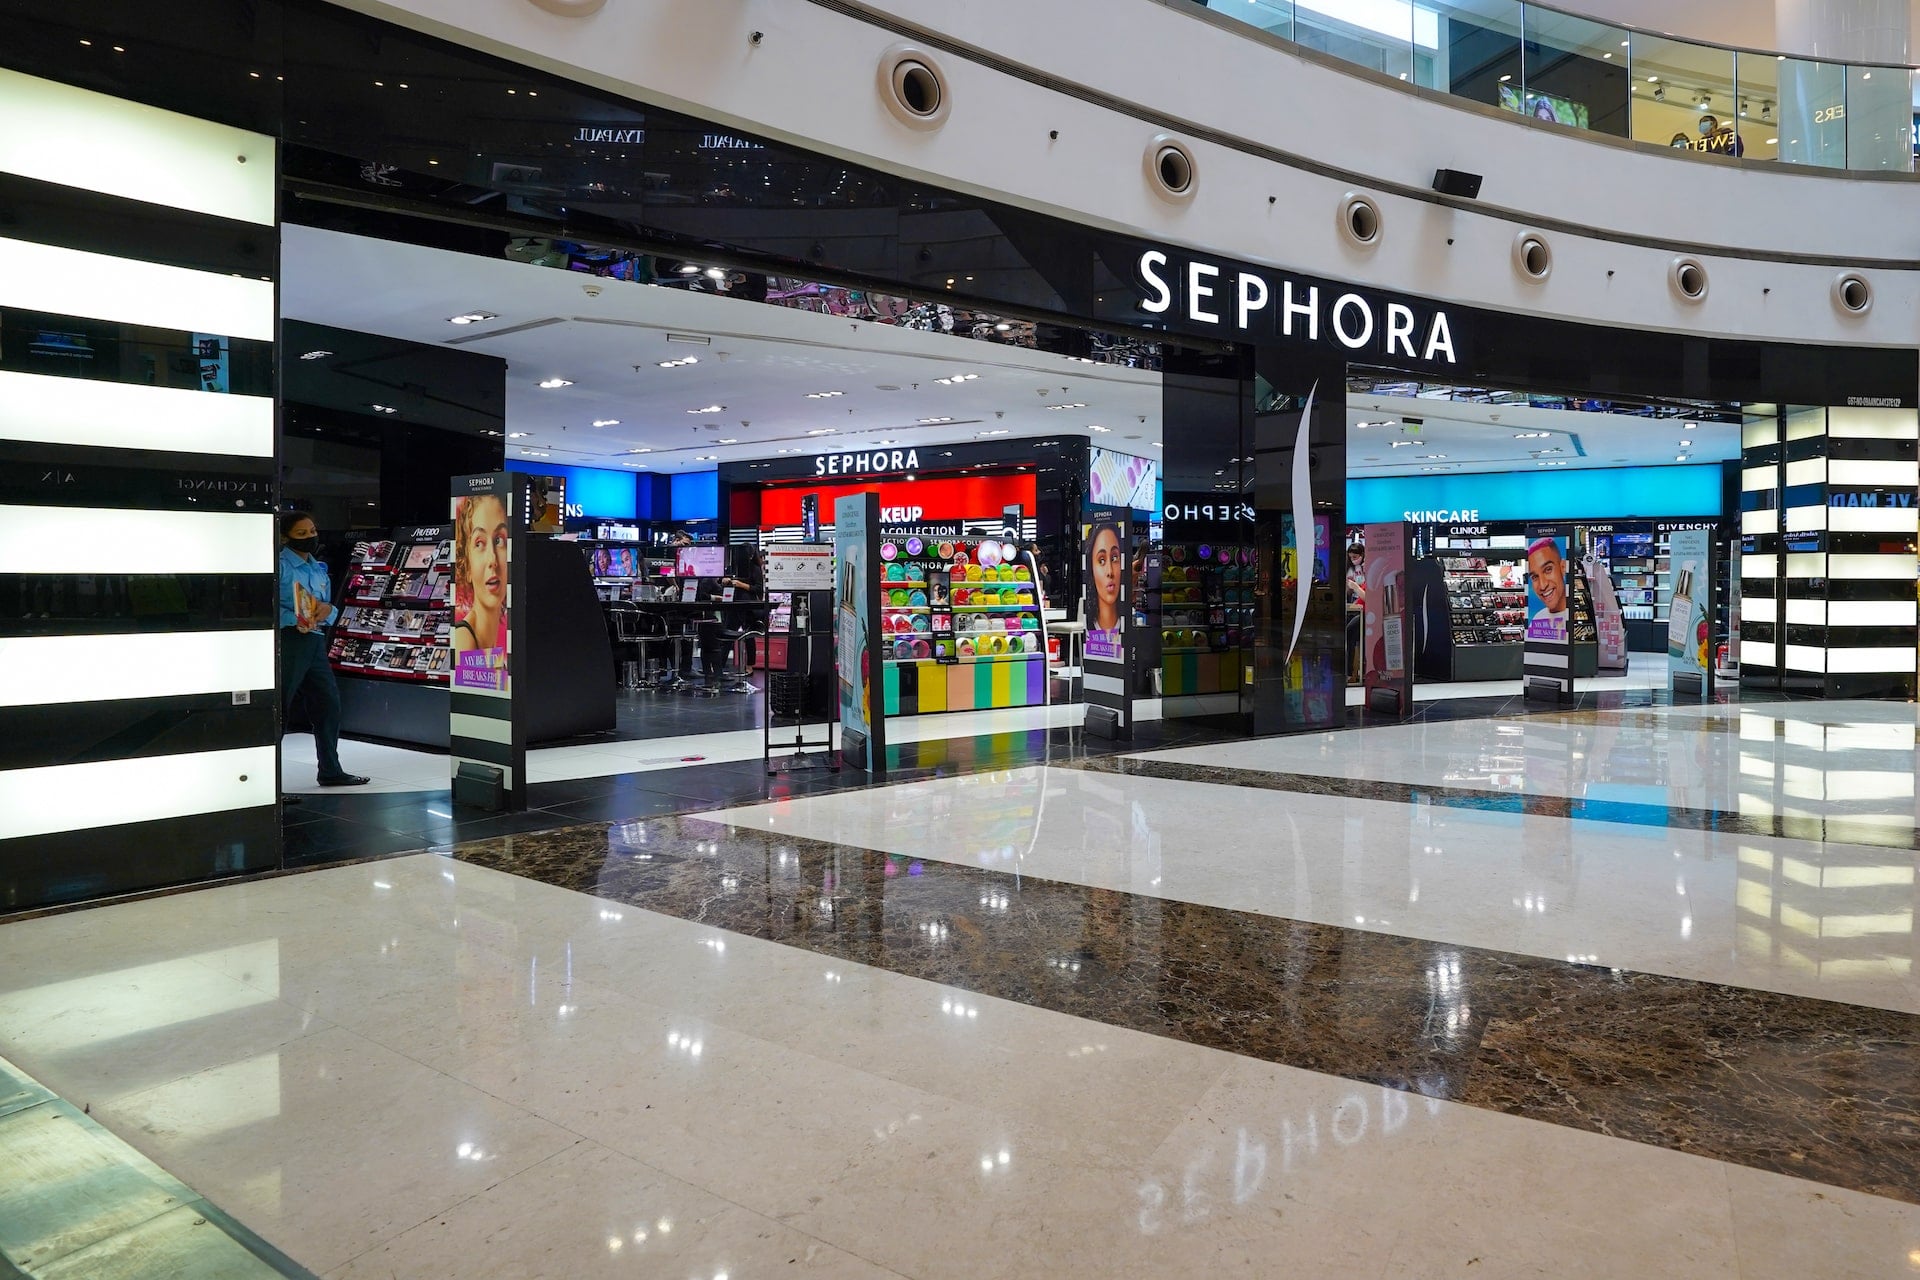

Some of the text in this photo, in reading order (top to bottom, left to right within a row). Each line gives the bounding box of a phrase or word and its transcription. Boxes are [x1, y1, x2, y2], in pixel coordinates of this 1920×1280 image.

[1139, 250, 1457, 364] SEPHORA
[815, 449, 920, 476] SEPHORA
[468, 477, 495, 487] SEPHORA
[879, 506, 923, 523] KEUP
[1403, 509, 1480, 524] SKINCARE
[888, 526, 956, 536] COLLECTION
[1450, 526, 1488, 535] CLINIQUE
[1657, 523, 1719, 531] GIVENCHY
[464, 655, 475, 666] MY
[462, 669, 488, 681] BREAKS
